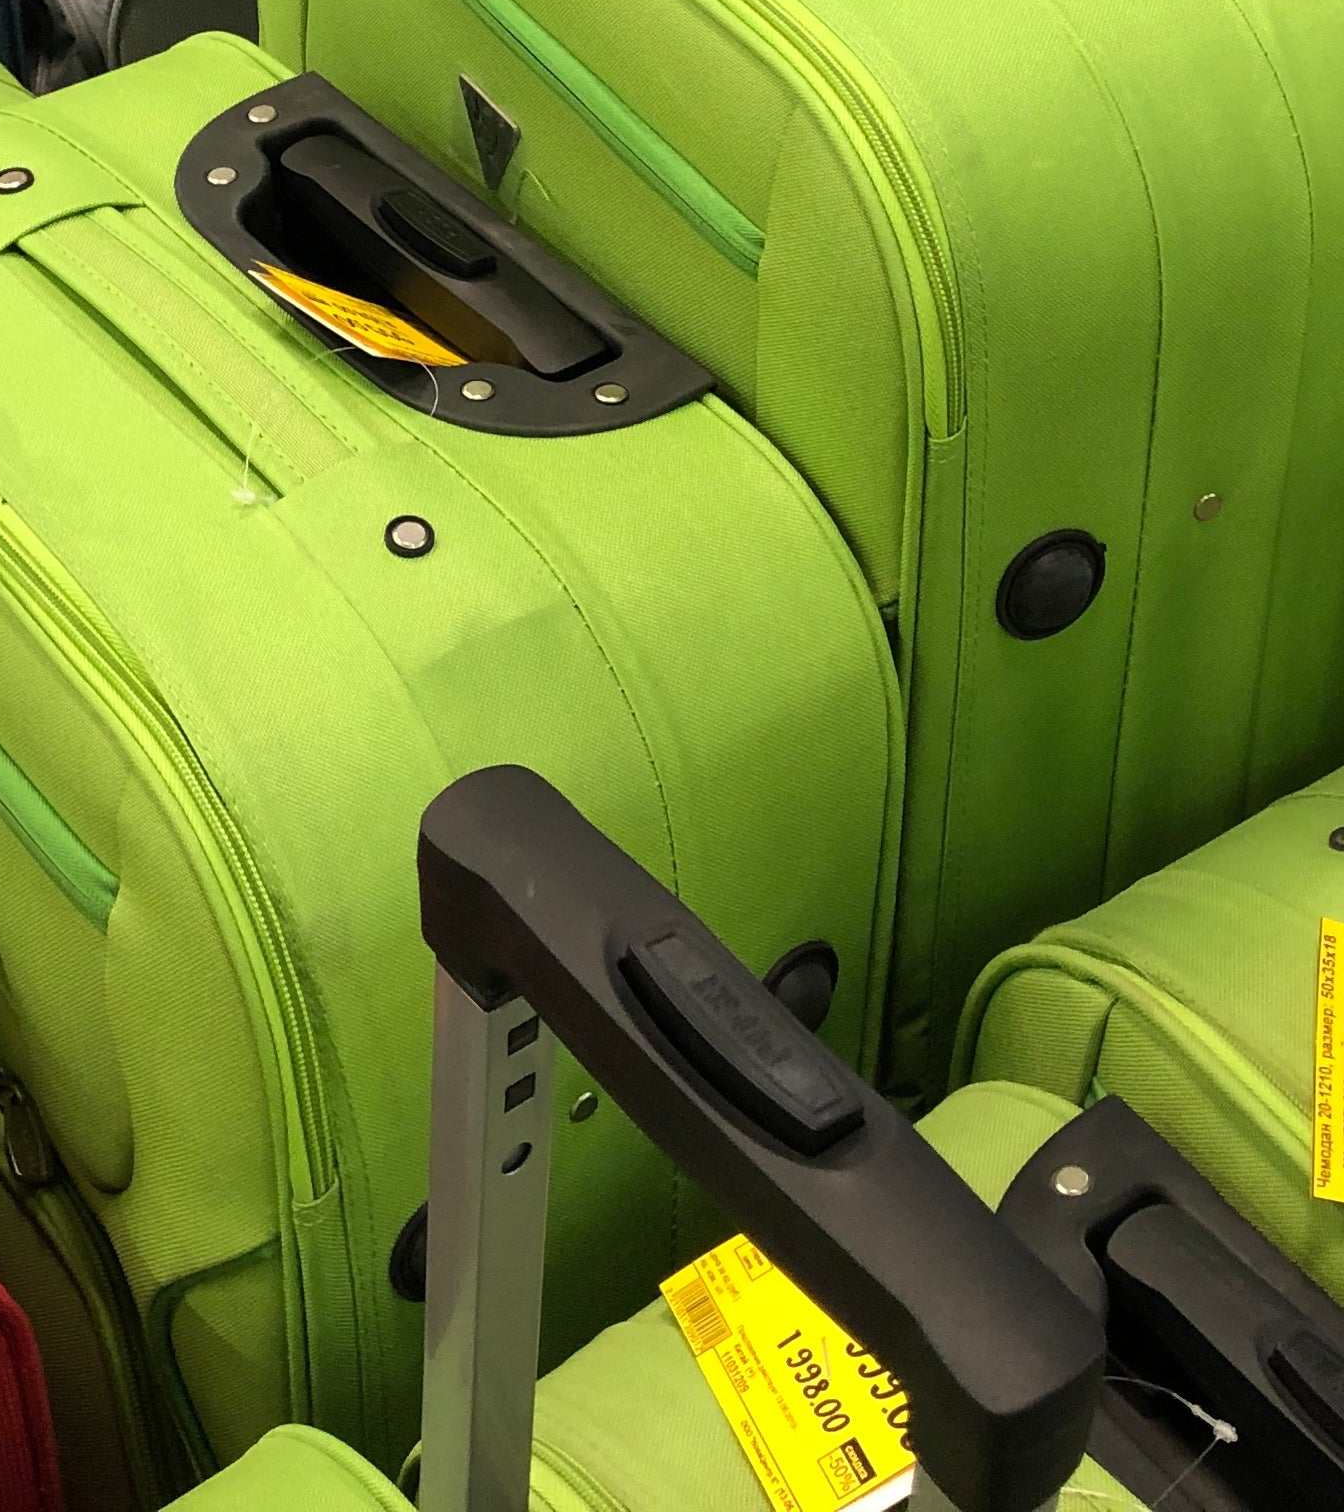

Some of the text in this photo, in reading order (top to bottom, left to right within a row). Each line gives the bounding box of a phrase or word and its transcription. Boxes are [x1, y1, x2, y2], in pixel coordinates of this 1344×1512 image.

[1317, 934, 1337, 1187] Чемодан 20-1210, размер: 50x35x18
[720, 1349, 751, 1394] 11031209
[786, 1348, 850, 1432] 998.00
[828, 1455, 857, 1492] -50%
[845, 1445, 868, 1480] скидка
